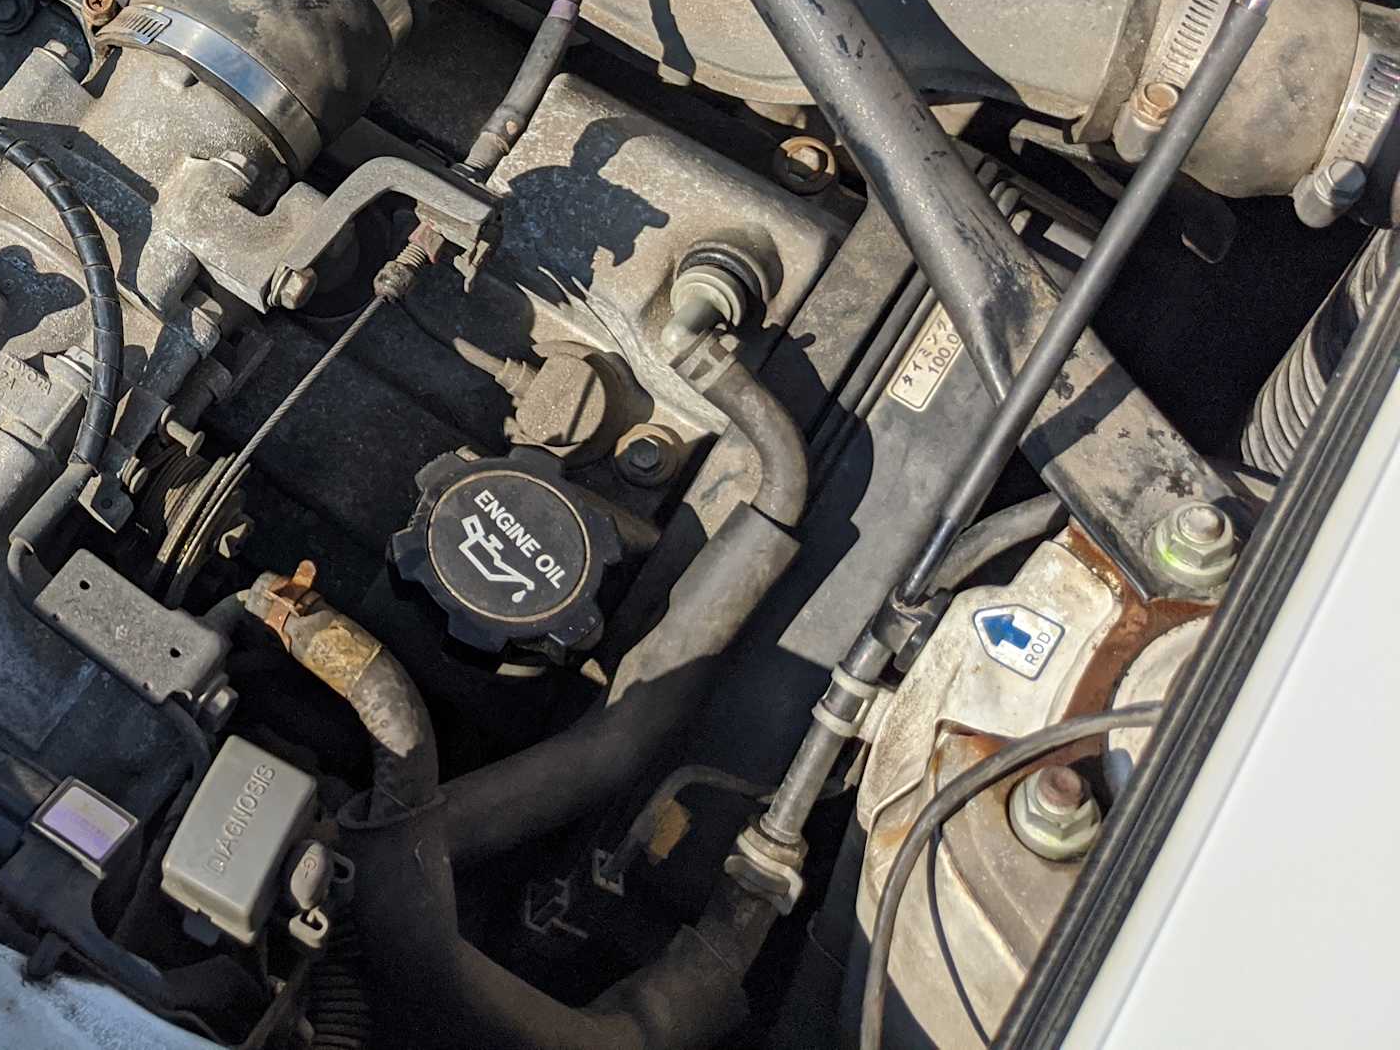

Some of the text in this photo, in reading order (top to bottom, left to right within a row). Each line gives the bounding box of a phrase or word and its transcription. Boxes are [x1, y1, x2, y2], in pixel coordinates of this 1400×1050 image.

[926, 332, 961, 375] 100.0
[473, 489, 569, 590] ENGINE OIL
[1024, 629, 1052, 668] ROD
[205, 762, 278, 878] DIAGNOSIS
